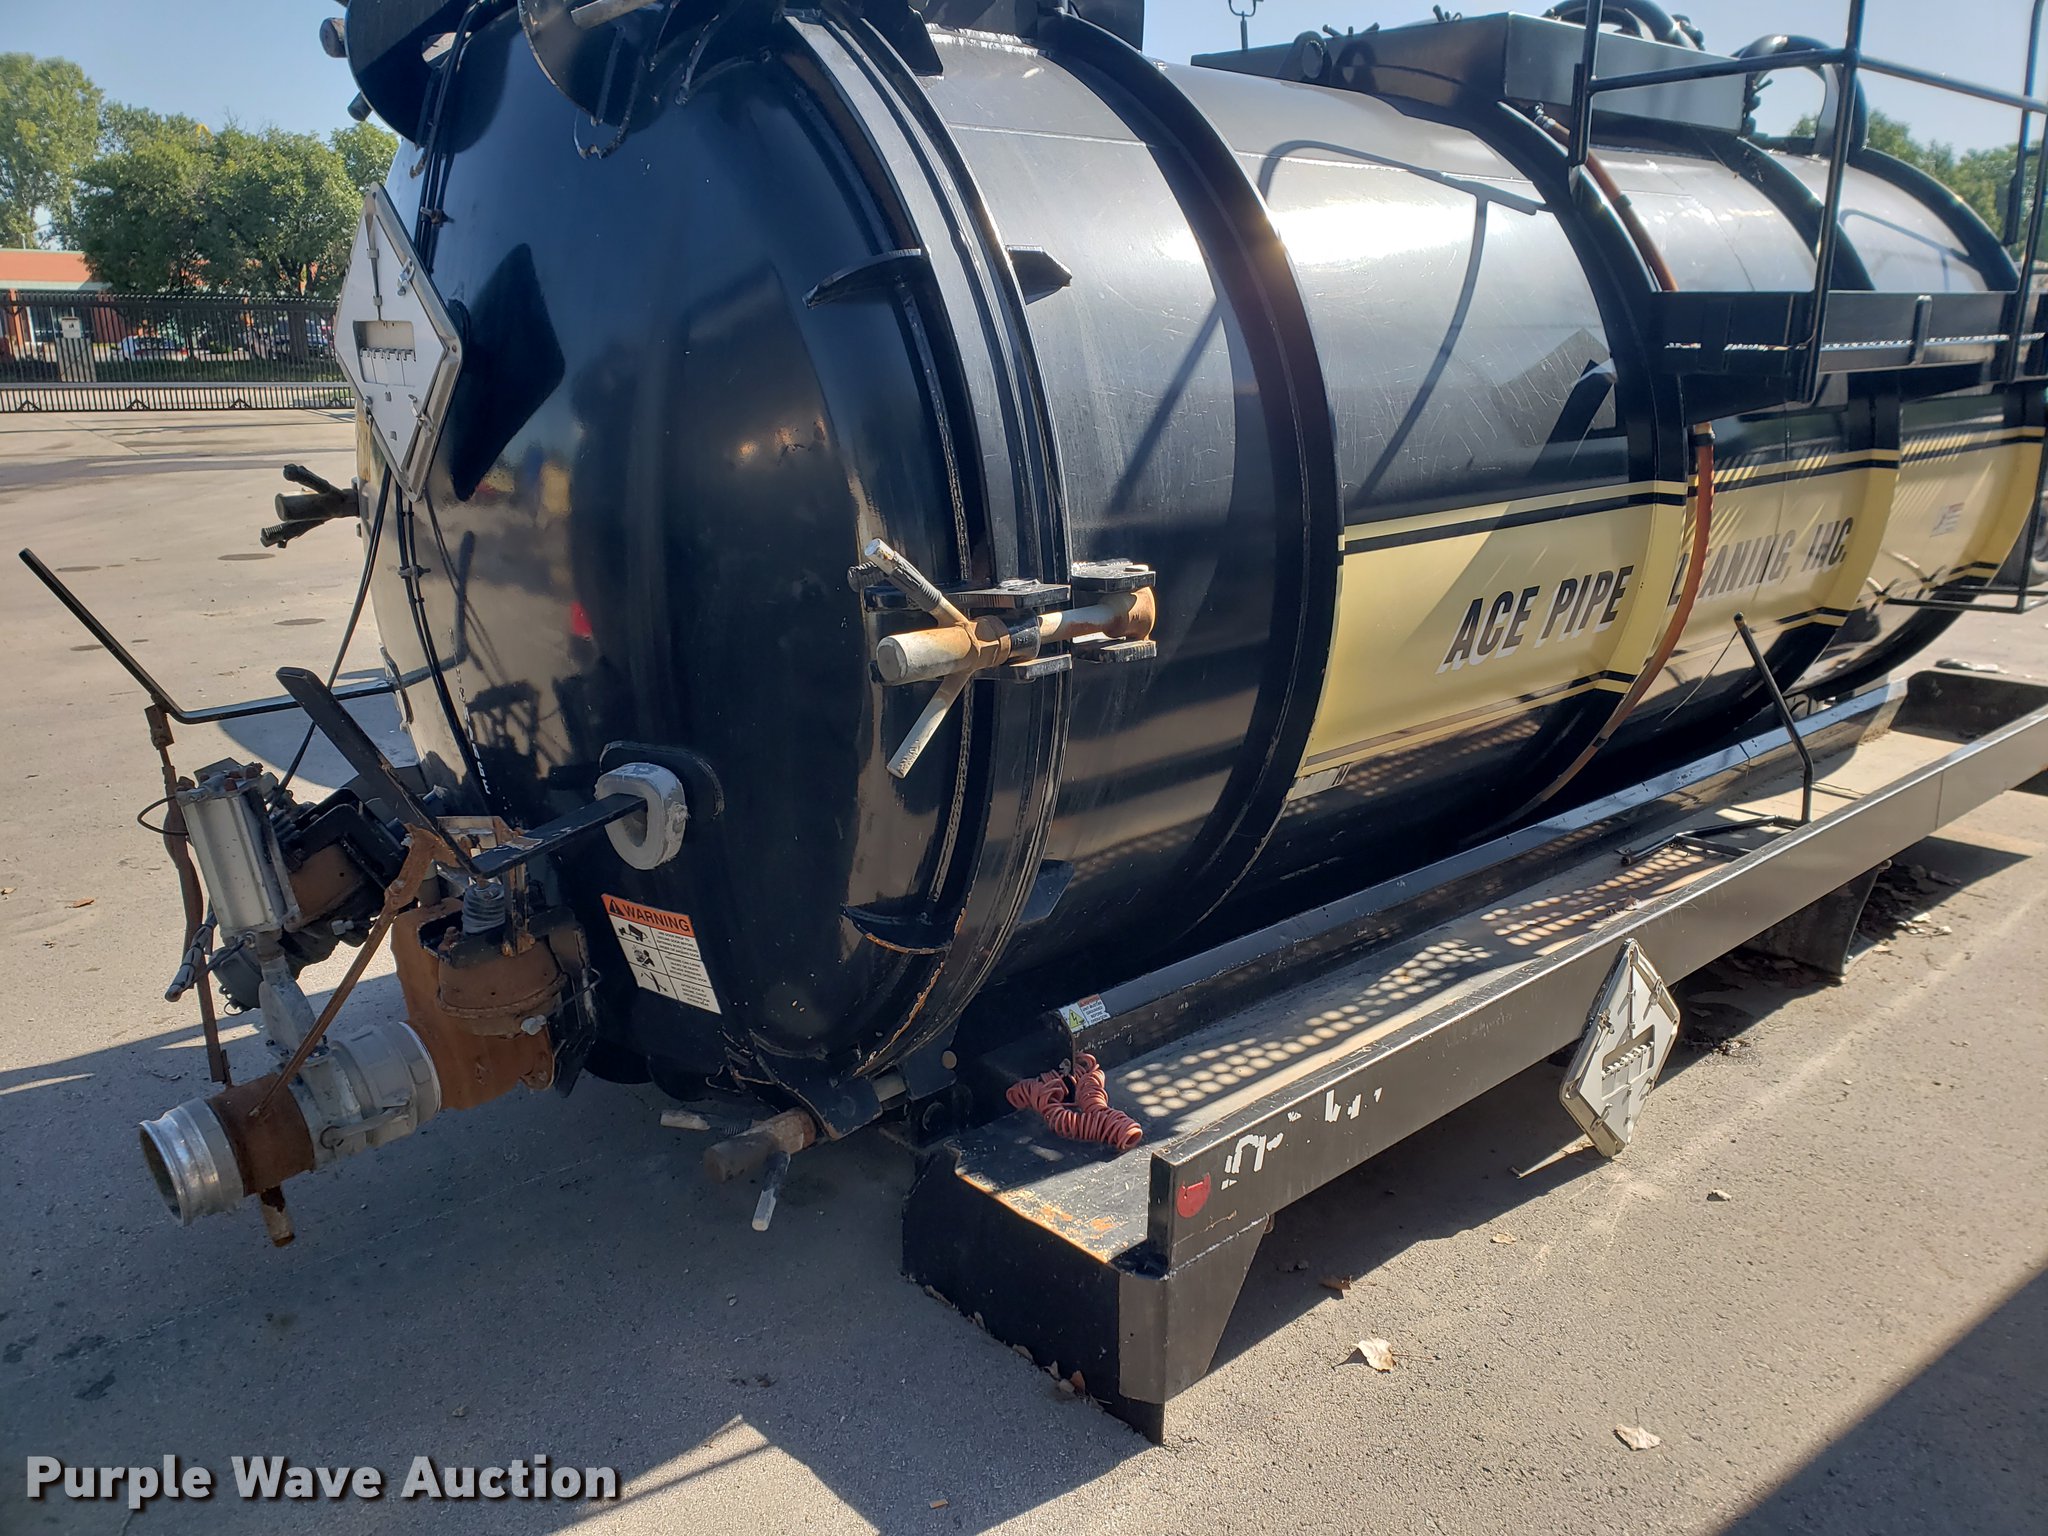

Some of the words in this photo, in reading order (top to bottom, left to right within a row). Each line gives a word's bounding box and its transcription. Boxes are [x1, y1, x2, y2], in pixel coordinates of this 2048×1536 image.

[1442, 585, 1541, 666] ACE
[1539, 564, 1635, 641] PIPE
[1667, 529, 1797, 607] LANING,
[622, 903, 690, 932] WARNING
